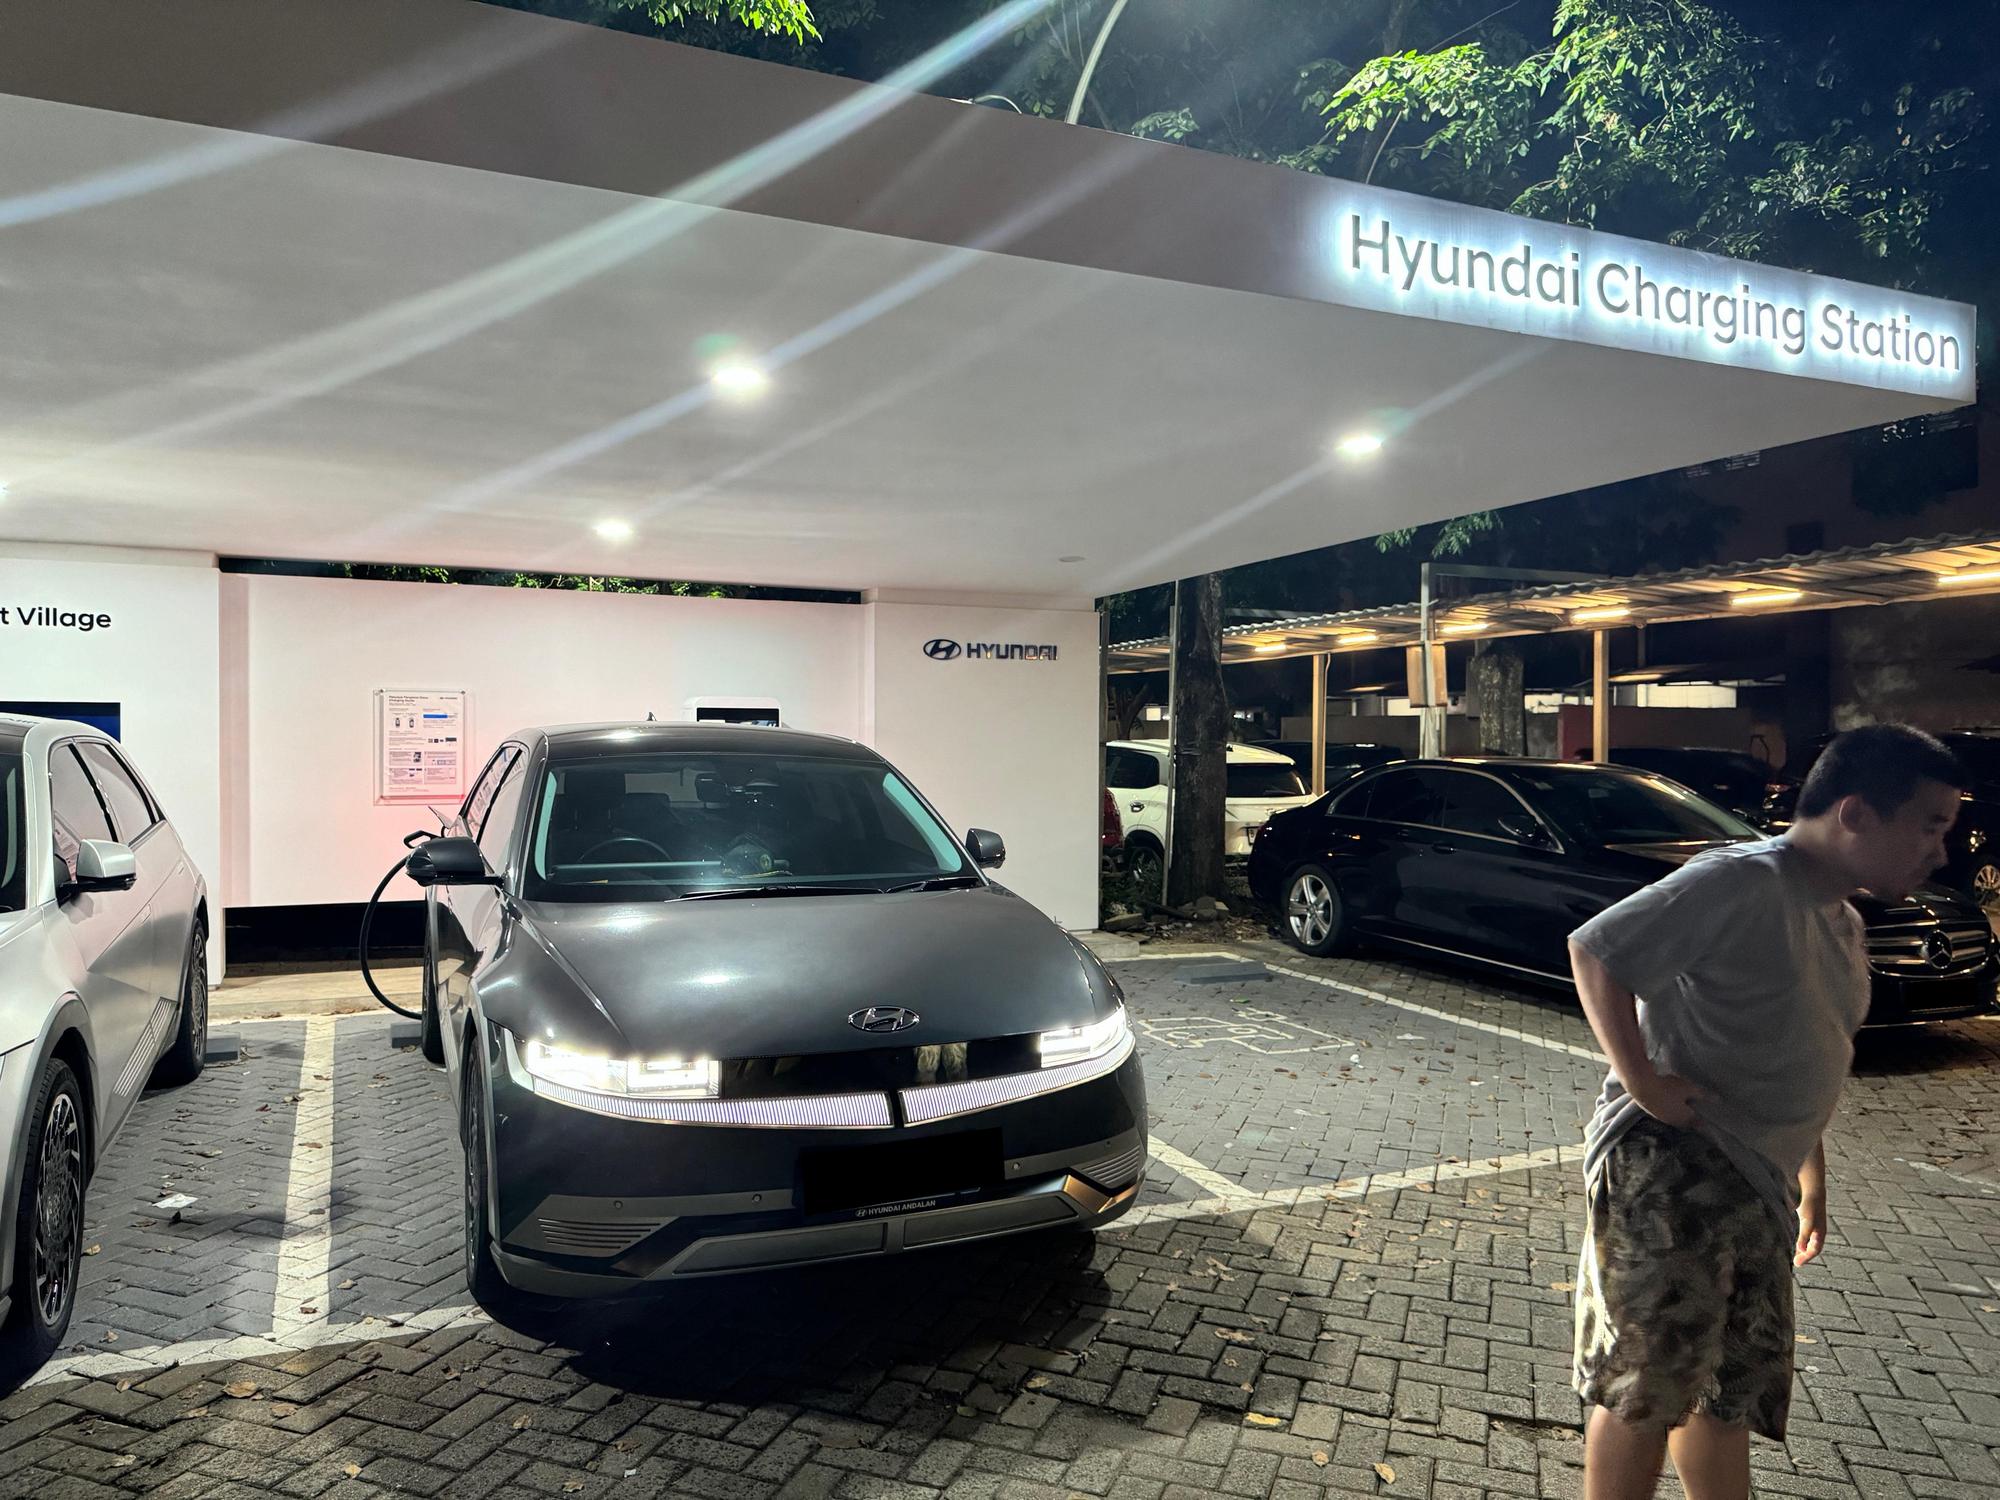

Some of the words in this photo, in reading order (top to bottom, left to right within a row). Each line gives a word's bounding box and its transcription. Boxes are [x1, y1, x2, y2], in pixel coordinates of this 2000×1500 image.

[1351, 215, 1580, 306] Hyundai
[1596, 263, 1806, 353] Charging
[1820, 303, 1961, 371] Station
[17, 606, 112, 632] Village
[967, 642, 1058, 661] HYUNDAI
[868, 1205, 901, 1216] HYUNDAI
[901, 1200, 936, 1211] ANDALAN
